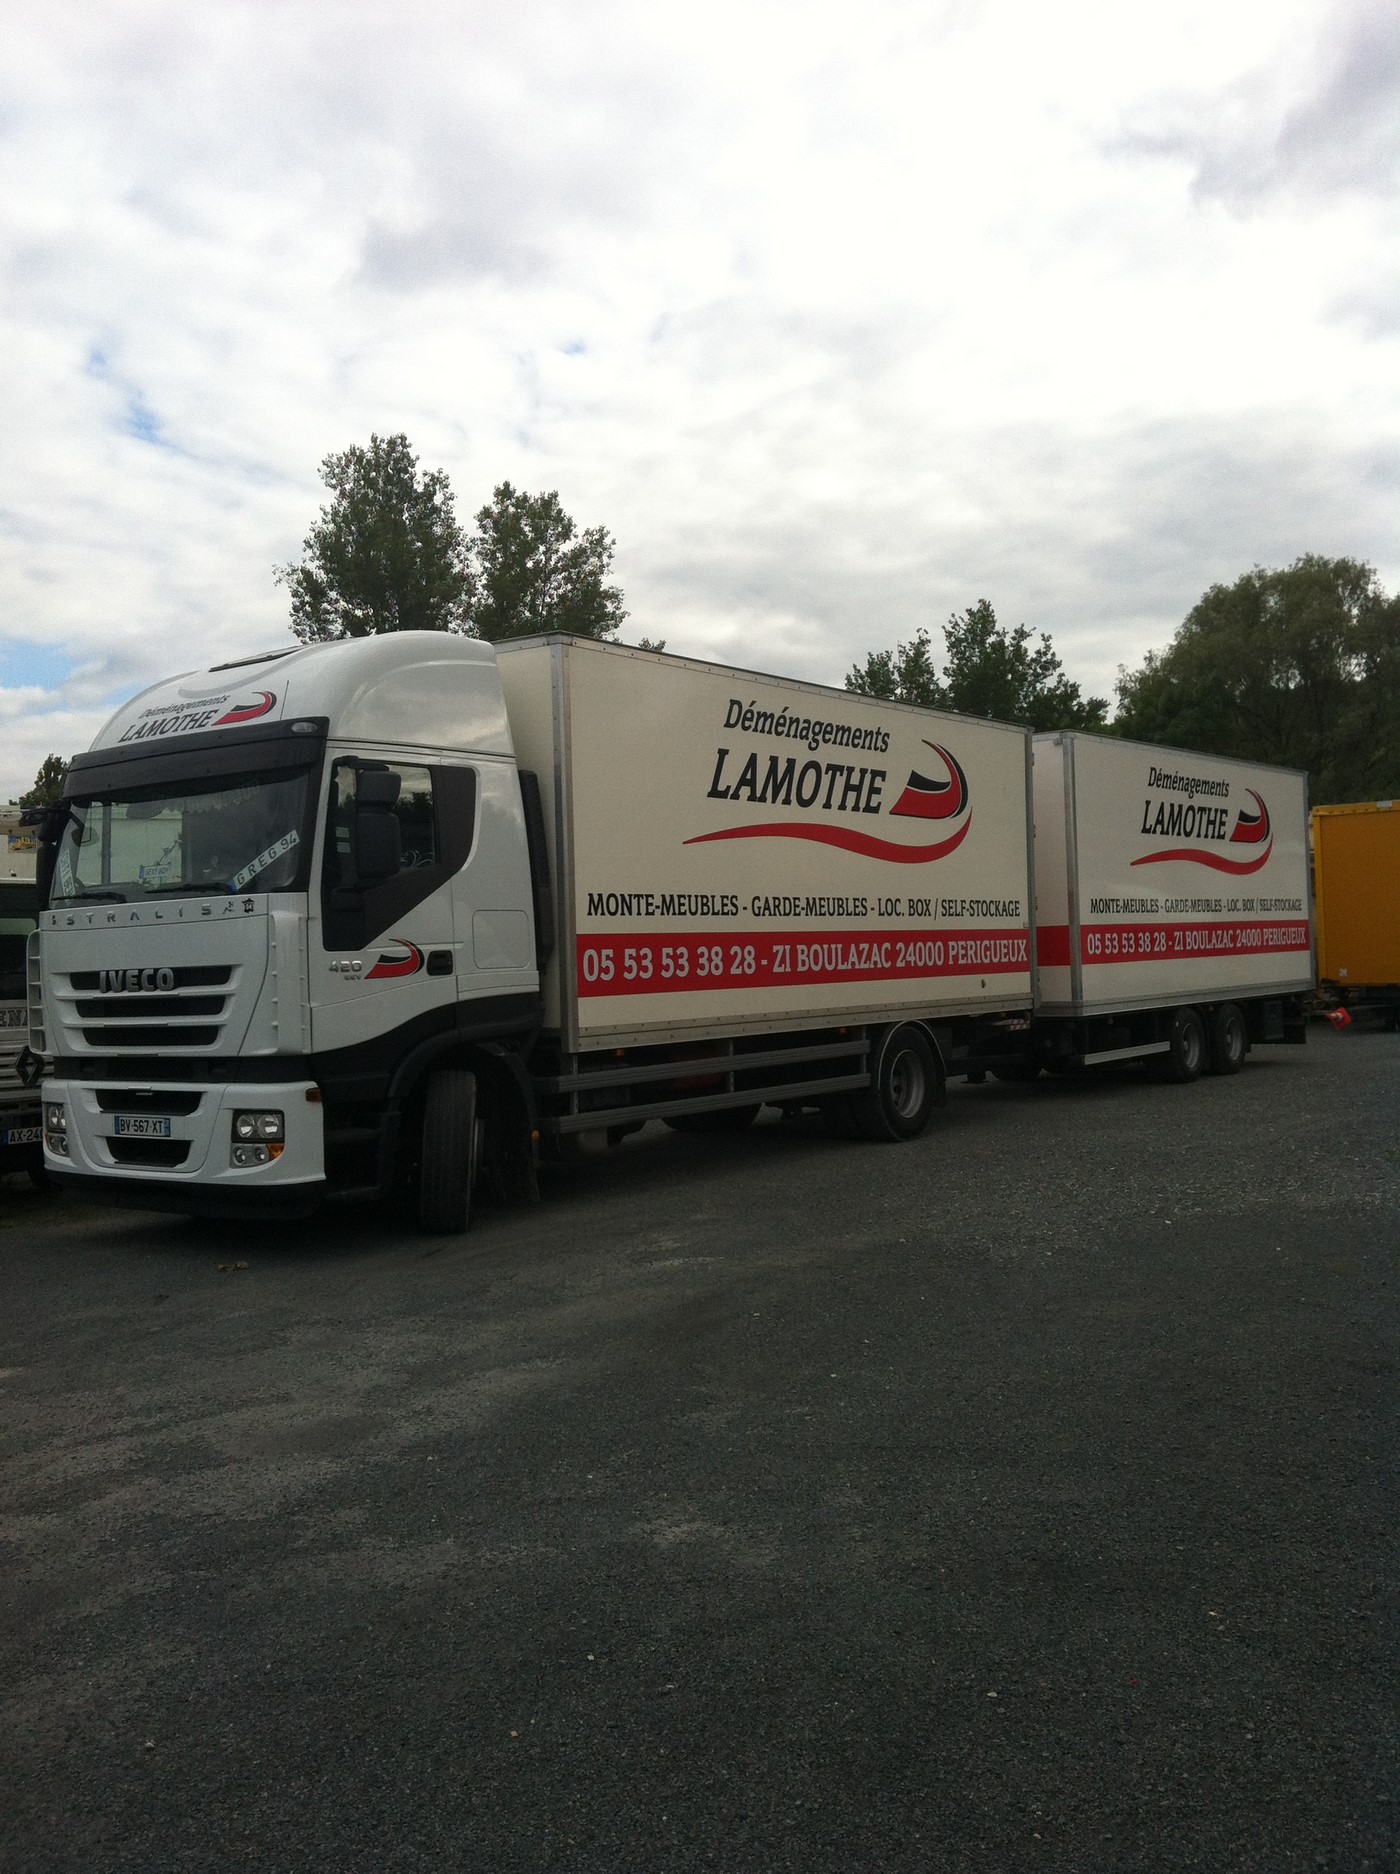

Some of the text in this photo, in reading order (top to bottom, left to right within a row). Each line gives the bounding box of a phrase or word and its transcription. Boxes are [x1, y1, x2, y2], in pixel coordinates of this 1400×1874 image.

[118, 709, 219, 743] LAMOTHE
[723, 698, 890, 753] Déménagements
[706, 748, 887, 814] LAMOTHE
[1147, 766, 1230, 799] Déménagements
[1141, 799, 1229, 840] LAMOTHE
[236, 833, 297, 886] GREG 94
[587, 893, 739, 917] MONTE-MEUBLES
[751, 895, 868, 917] GARDE-MEUBLES
[877, 898, 905, 917] LOC.
[907, 898, 932, 917] BOX
[941, 899, 1021, 917] SELF-STOCKAGE
[1090, 898, 1159, 914] MONTE-MEUBLES
[1164, 898, 1222, 913] GARDE-MEUBLES
[1242, 899, 1255, 912] BOX
[1259, 899, 1302, 912] SELF-STOCKAGE
[1087, 933, 1101, 955] 05
[1105, 932, 1119, 954] 53
[1121, 932, 1135, 953] 53
[1138, 932, 1151, 952] 38
[1153, 931, 1167, 952] 28
[1174, 931, 1184, 950] ZI
[1186, 929, 1234, 950] BOULAZAC
[1236, 928, 1261, 947] 24000
[1263, 927, 1307, 945] PERIGUEUX
[329, 960, 362, 972] 420
[583, 949, 615, 982] 05
[623, 947, 654, 980] 53
[660, 947, 690, 978] 53
[696, 946, 724, 976] 38
[730, 945, 756, 975] 28
[772, 945, 791, 973] ZI
[797, 942, 891, 972] BOULAZAC
[896, 941, 945, 967] 24000
[948, 939, 1028, 965] PERIGUEUX
[100, 967, 174, 993] IVECO
